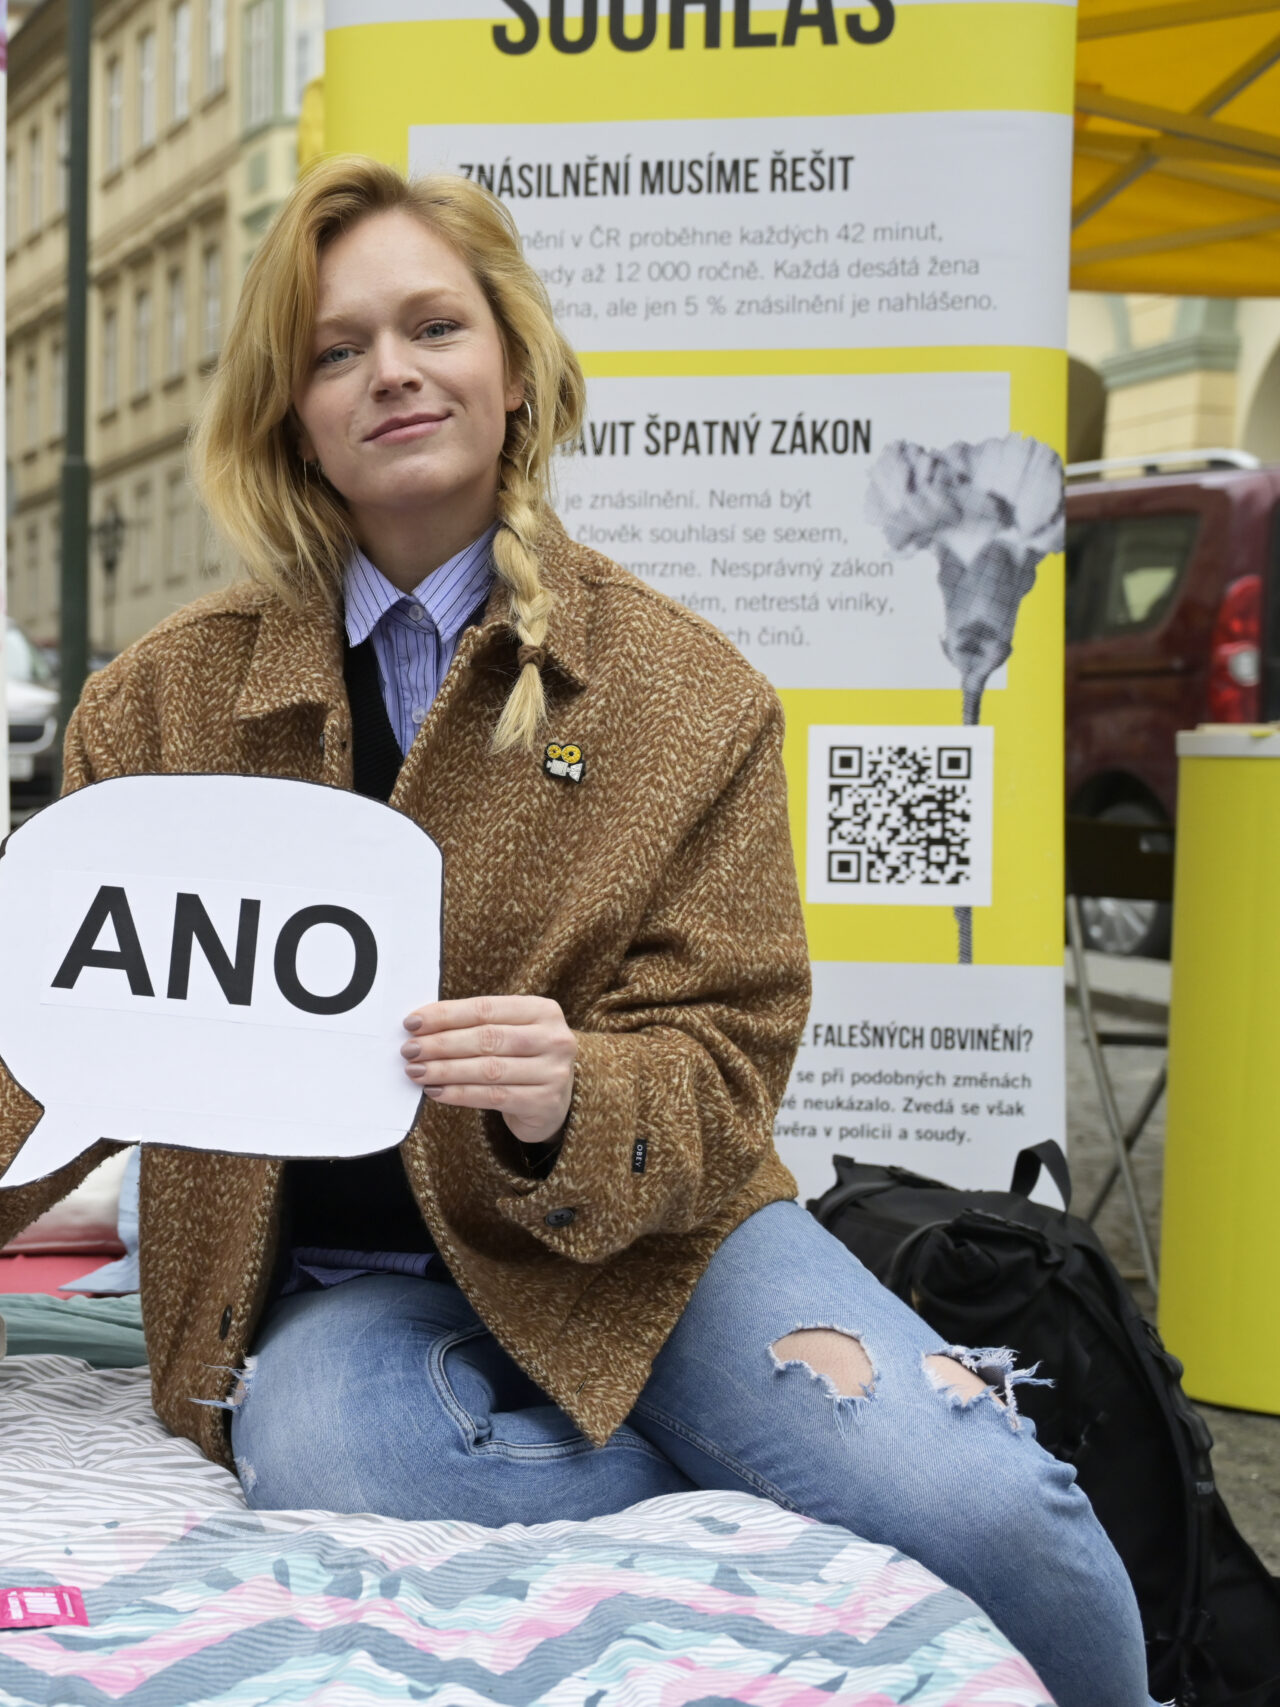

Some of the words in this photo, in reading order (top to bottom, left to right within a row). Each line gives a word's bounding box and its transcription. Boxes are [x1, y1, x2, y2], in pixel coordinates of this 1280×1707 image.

[640, 151, 760, 196] MUSÍME
[770, 149, 854, 193] ŘEŠIT
[571, 234, 583, 249] v
[589, 225, 622, 249] ČR
[629, 227, 732, 251] proběhne
[739, 225, 829, 249] každých
[836, 222, 866, 244] 42
[872, 221, 944, 243] minut,
[616, 261, 641, 283] 12
[647, 260, 691, 283] 000
[697, 259, 765, 281] ročně.
[773, 258, 840, 281] Každá
[847, 256, 920, 280] desátá
[927, 254, 980, 277] žena
[606, 297, 637, 318] ale
[644, 297, 677, 321] jen
[684, 296, 698, 317] 5
[707, 295, 726, 317] %
[735, 293, 845, 316] znásilnění
[852, 293, 870, 318] je
[878, 289, 997, 314] nahlášeno.
[644, 412, 761, 457] ŠPATNÝ
[770, 412, 873, 456] ZÁKON
[589, 488, 701, 511] znásilnění.
[708, 487, 772, 510] Nemá
[779, 487, 812, 513] být
[649, 523, 737, 544] souhlasí
[742, 526, 766, 544] se
[775, 526, 849, 547] sexem,
[710, 556, 822, 582] Nesprávný
[830, 556, 895, 579] zákon
[735, 592, 820, 613] netrestá
[827, 590, 895, 616] viníky,
[50, 885, 378, 1016] ANO
[813, 1020, 924, 1050] FALEŠNÝCH
[930, 1023, 1033, 1053] OBVINĚNÍ?
[796, 1069, 814, 1084] se
[821, 1067, 845, 1087] při
[851, 1069, 947, 1090] podobných
[952, 1071, 1032, 1090] změnách
[803, 1095, 896, 1113] neukázalo.
[902, 1096, 954, 1115] Zvedá
[961, 1101, 981, 1117] se
[986, 1099, 1025, 1117] však
[823, 1125, 833, 1138] v
[839, 1122, 892, 1142] policii
[898, 1127, 908, 1140] a
[915, 1125, 972, 1146] soudy.
[635, 1144, 644, 1168] OBEY
